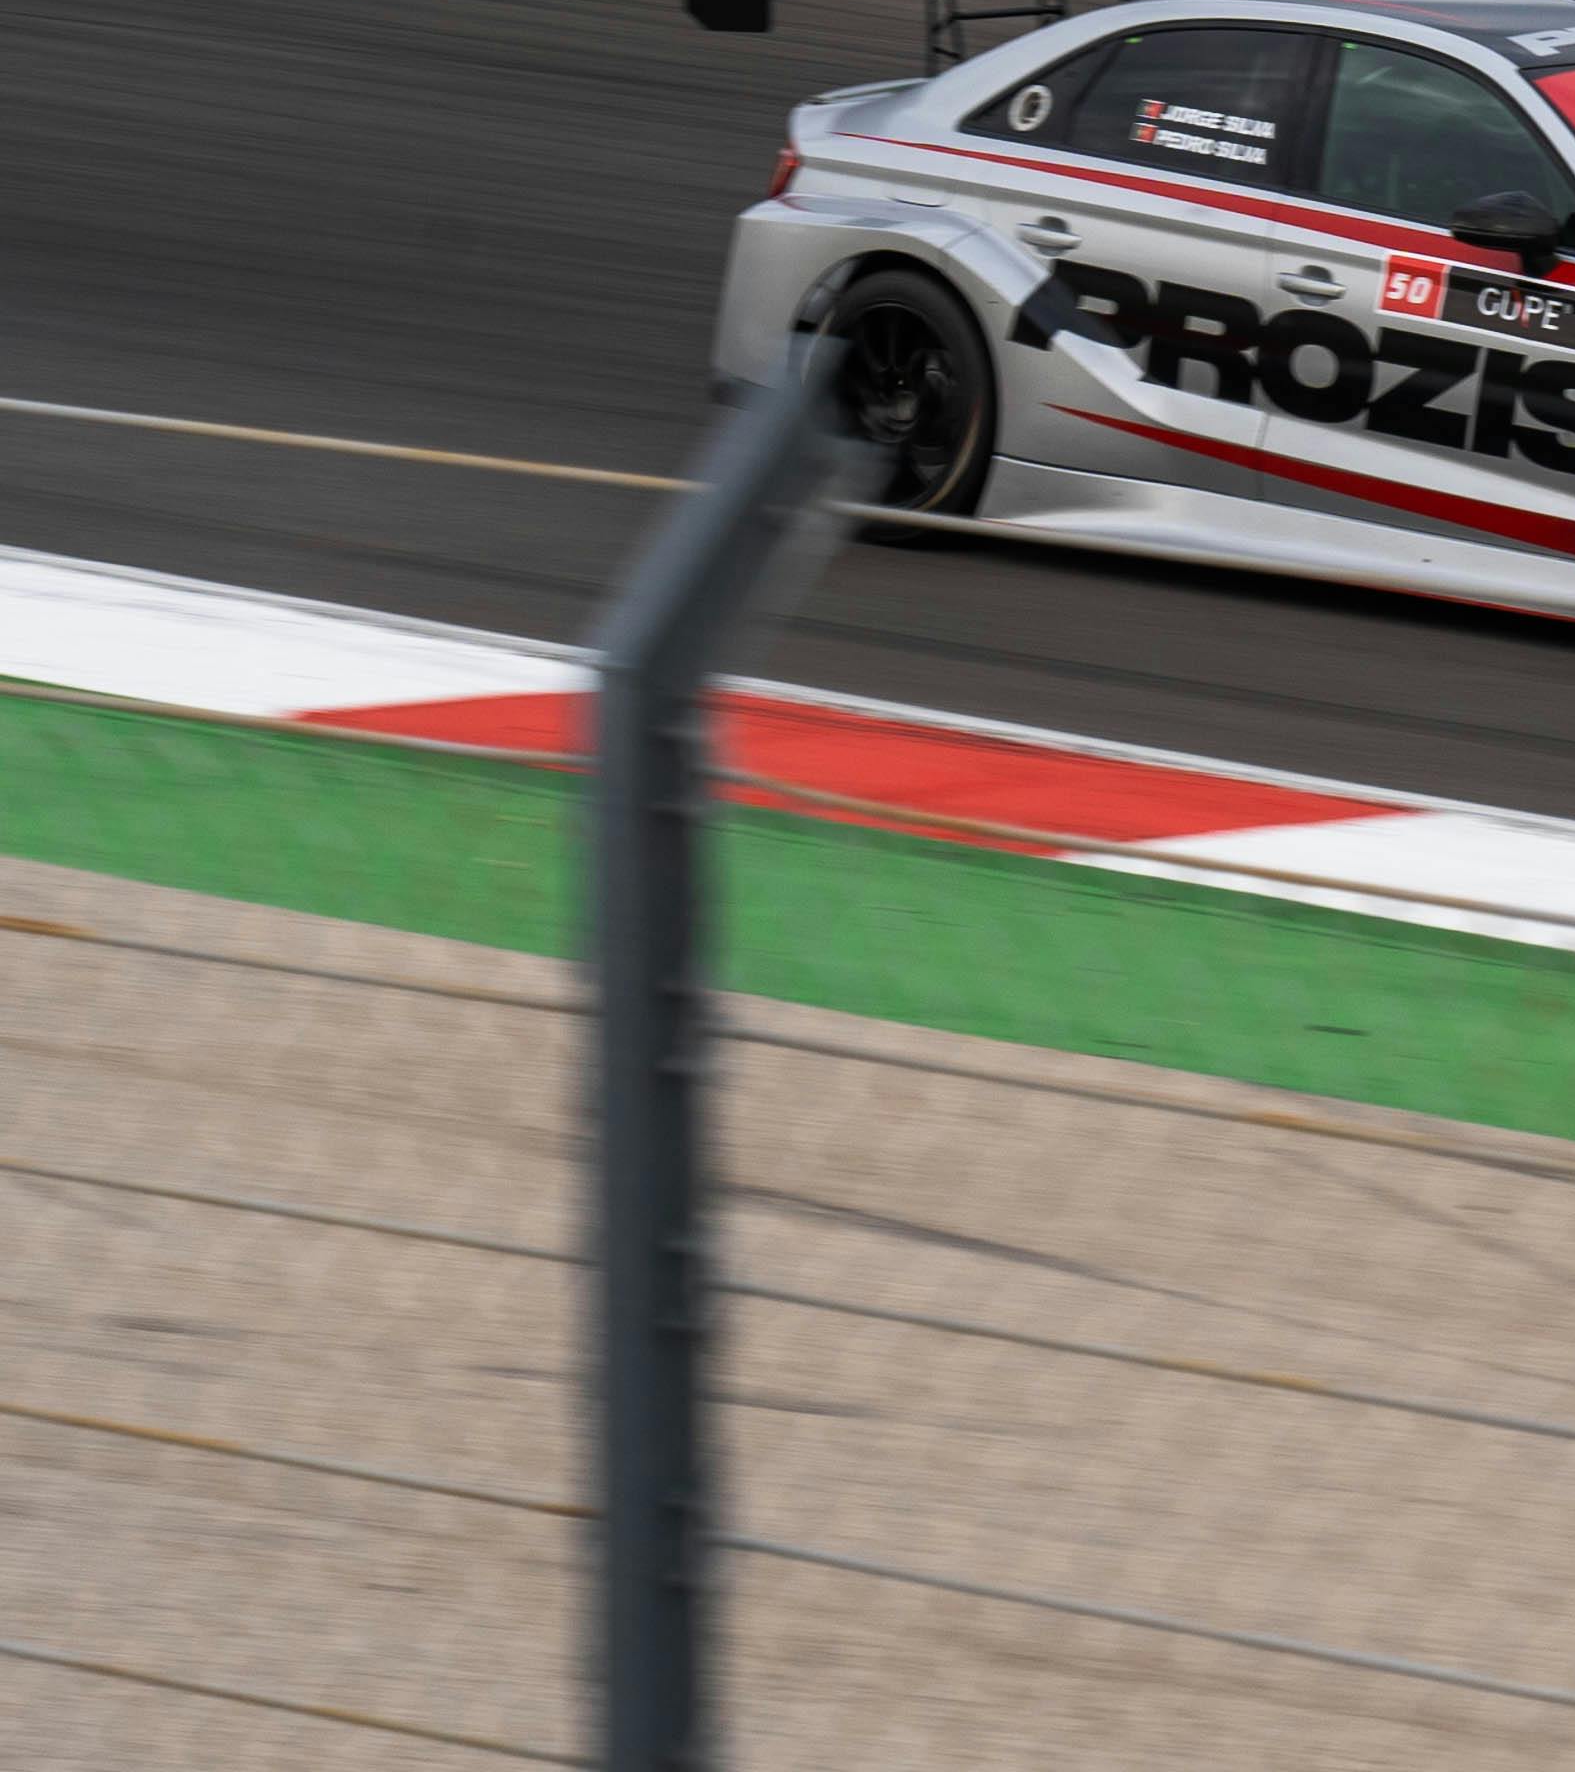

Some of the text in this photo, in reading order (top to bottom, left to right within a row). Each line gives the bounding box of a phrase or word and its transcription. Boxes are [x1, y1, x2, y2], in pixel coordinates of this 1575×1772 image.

[1223, 115, 1276, 140] SILVA
[1214, 140, 1267, 165] SILVA
[1386, 272, 1434, 305] 50
